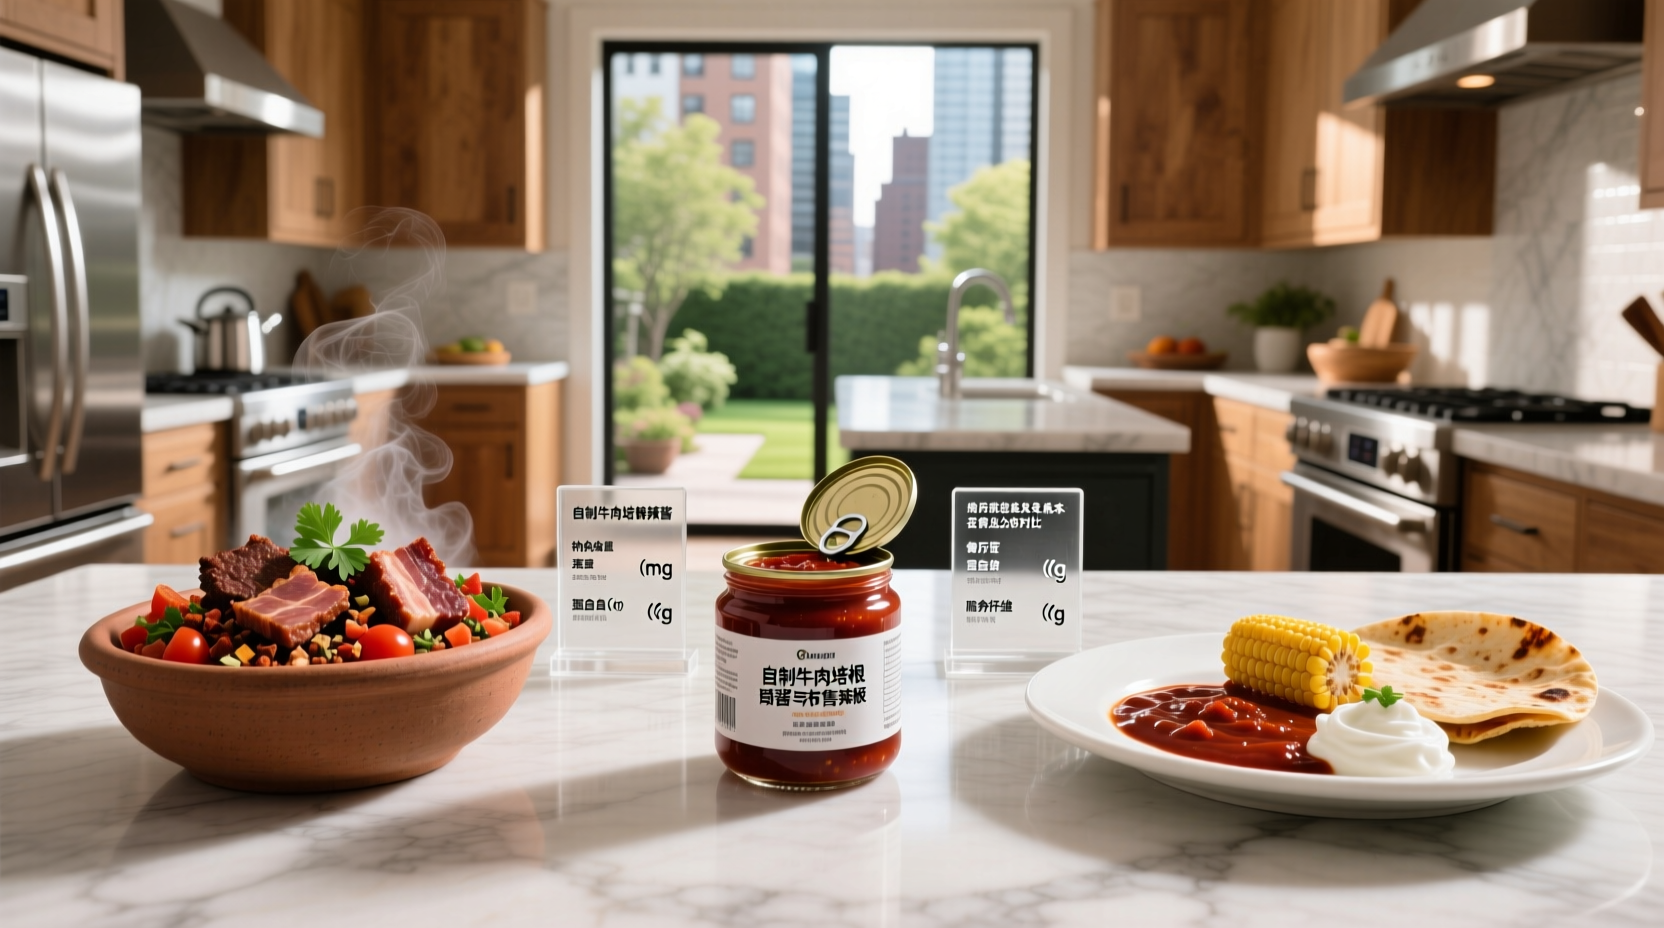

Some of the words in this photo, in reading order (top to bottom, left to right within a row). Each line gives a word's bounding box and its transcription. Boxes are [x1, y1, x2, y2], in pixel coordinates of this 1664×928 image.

[762, 664, 866, 687] 自制牛肉培根
